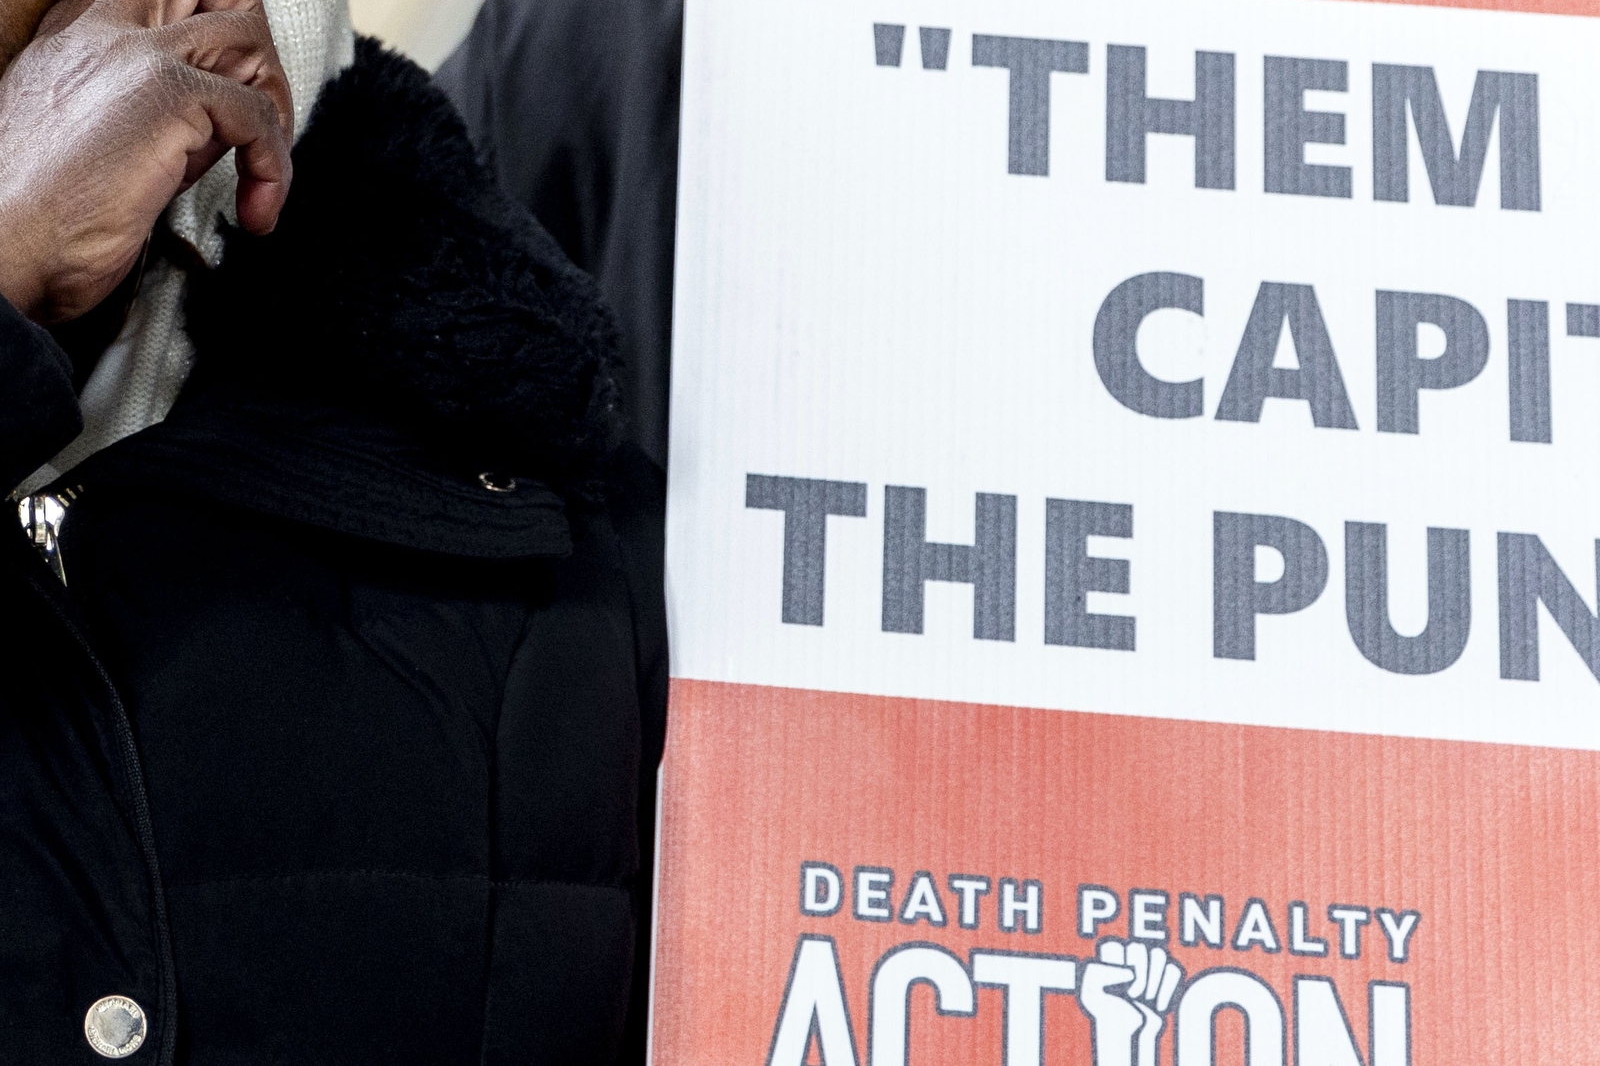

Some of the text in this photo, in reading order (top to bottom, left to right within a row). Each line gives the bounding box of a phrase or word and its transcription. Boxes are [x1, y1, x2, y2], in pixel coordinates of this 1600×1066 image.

[873, 22, 1543, 214] "THEM
[1092, 271, 1600, 445] CAPI
[745, 472, 1600, 686] THE PUN
[800, 860, 1421, 963] DEATH PENALTY
